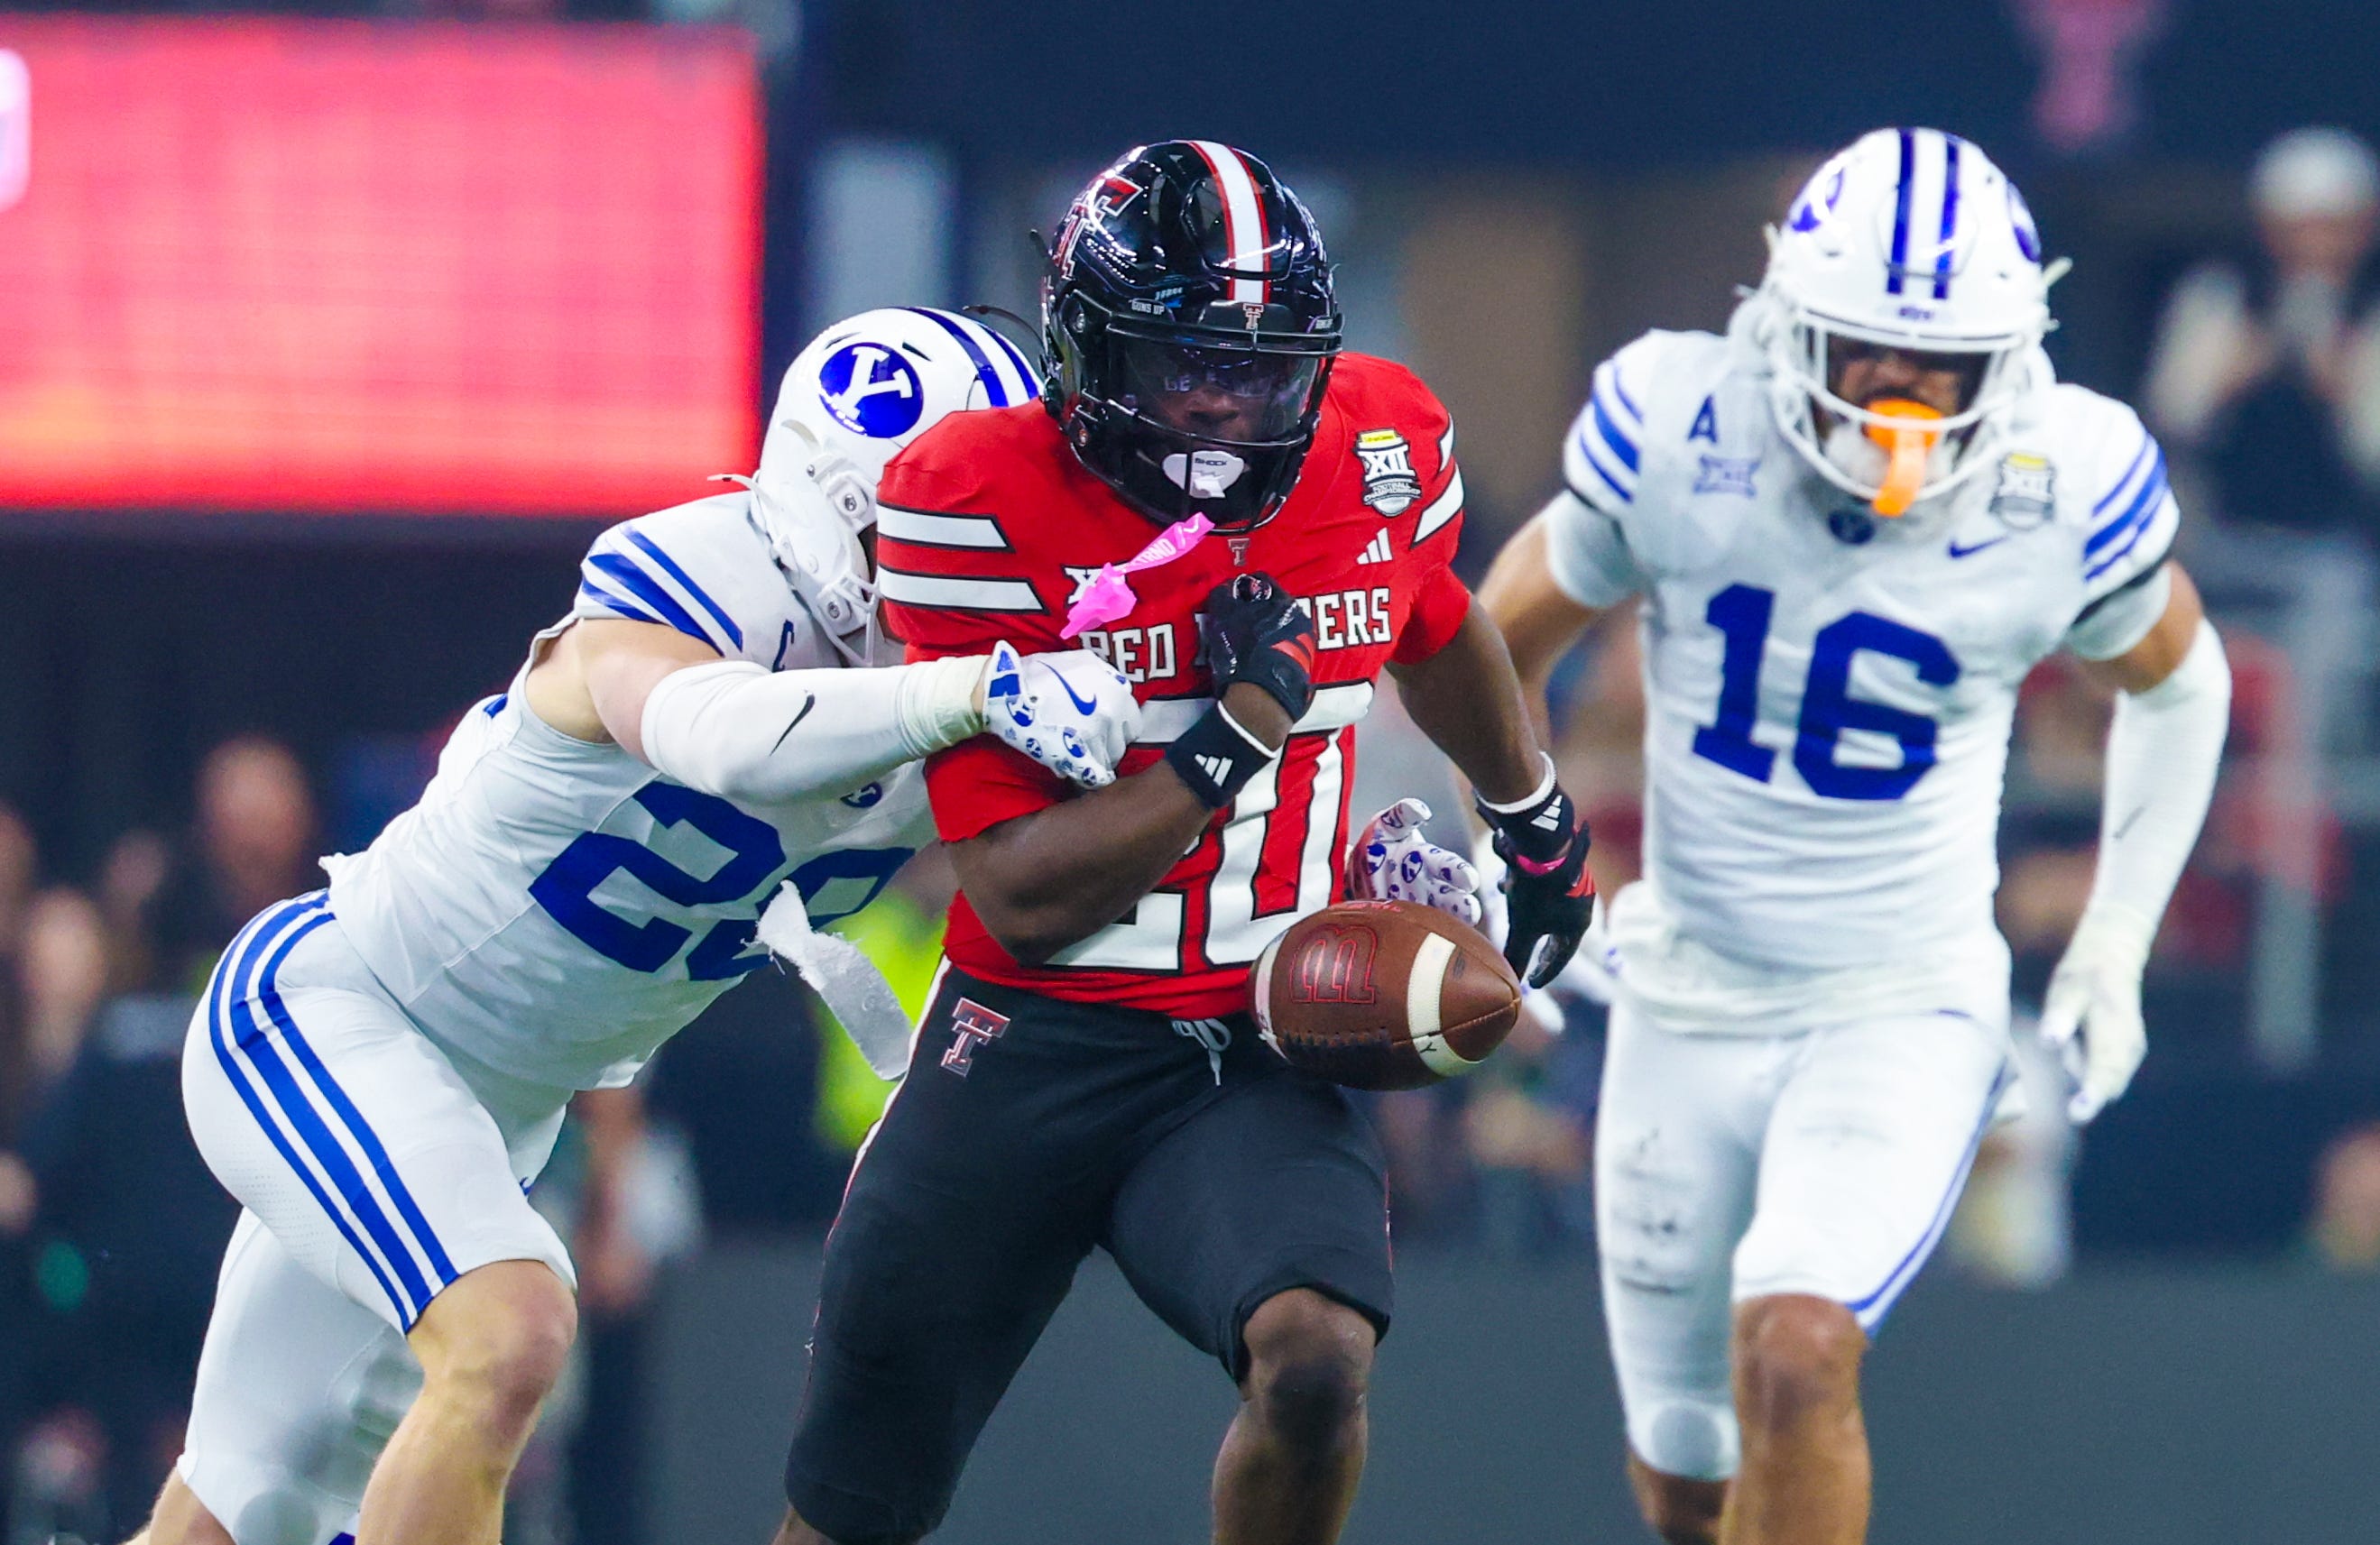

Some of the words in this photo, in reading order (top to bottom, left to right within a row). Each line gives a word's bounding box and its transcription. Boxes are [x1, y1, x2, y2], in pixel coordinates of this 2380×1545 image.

[1687, 394, 1717, 443] A
[1079, 622, 1176, 683] RED
[1692, 582, 1960, 801] 16
